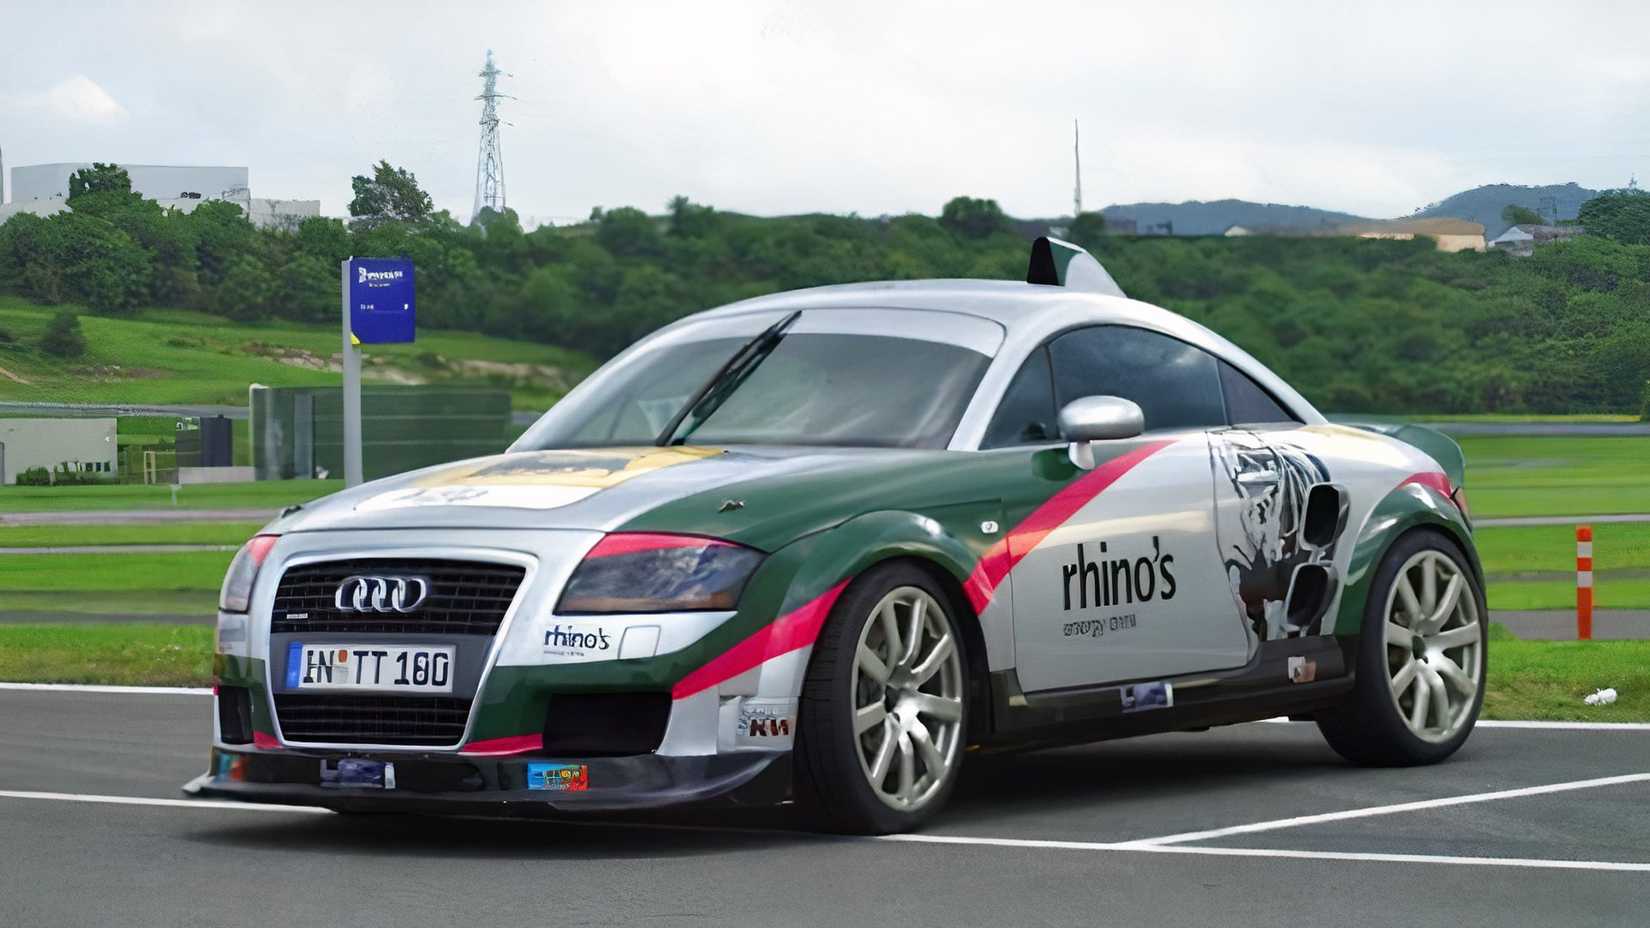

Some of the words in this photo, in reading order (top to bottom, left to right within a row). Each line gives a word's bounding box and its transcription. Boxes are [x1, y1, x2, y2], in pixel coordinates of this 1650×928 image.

[1063, 536, 1176, 610] rhino's
[544, 625, 610, 650] rhino's
[353, 650, 387, 684] TT
